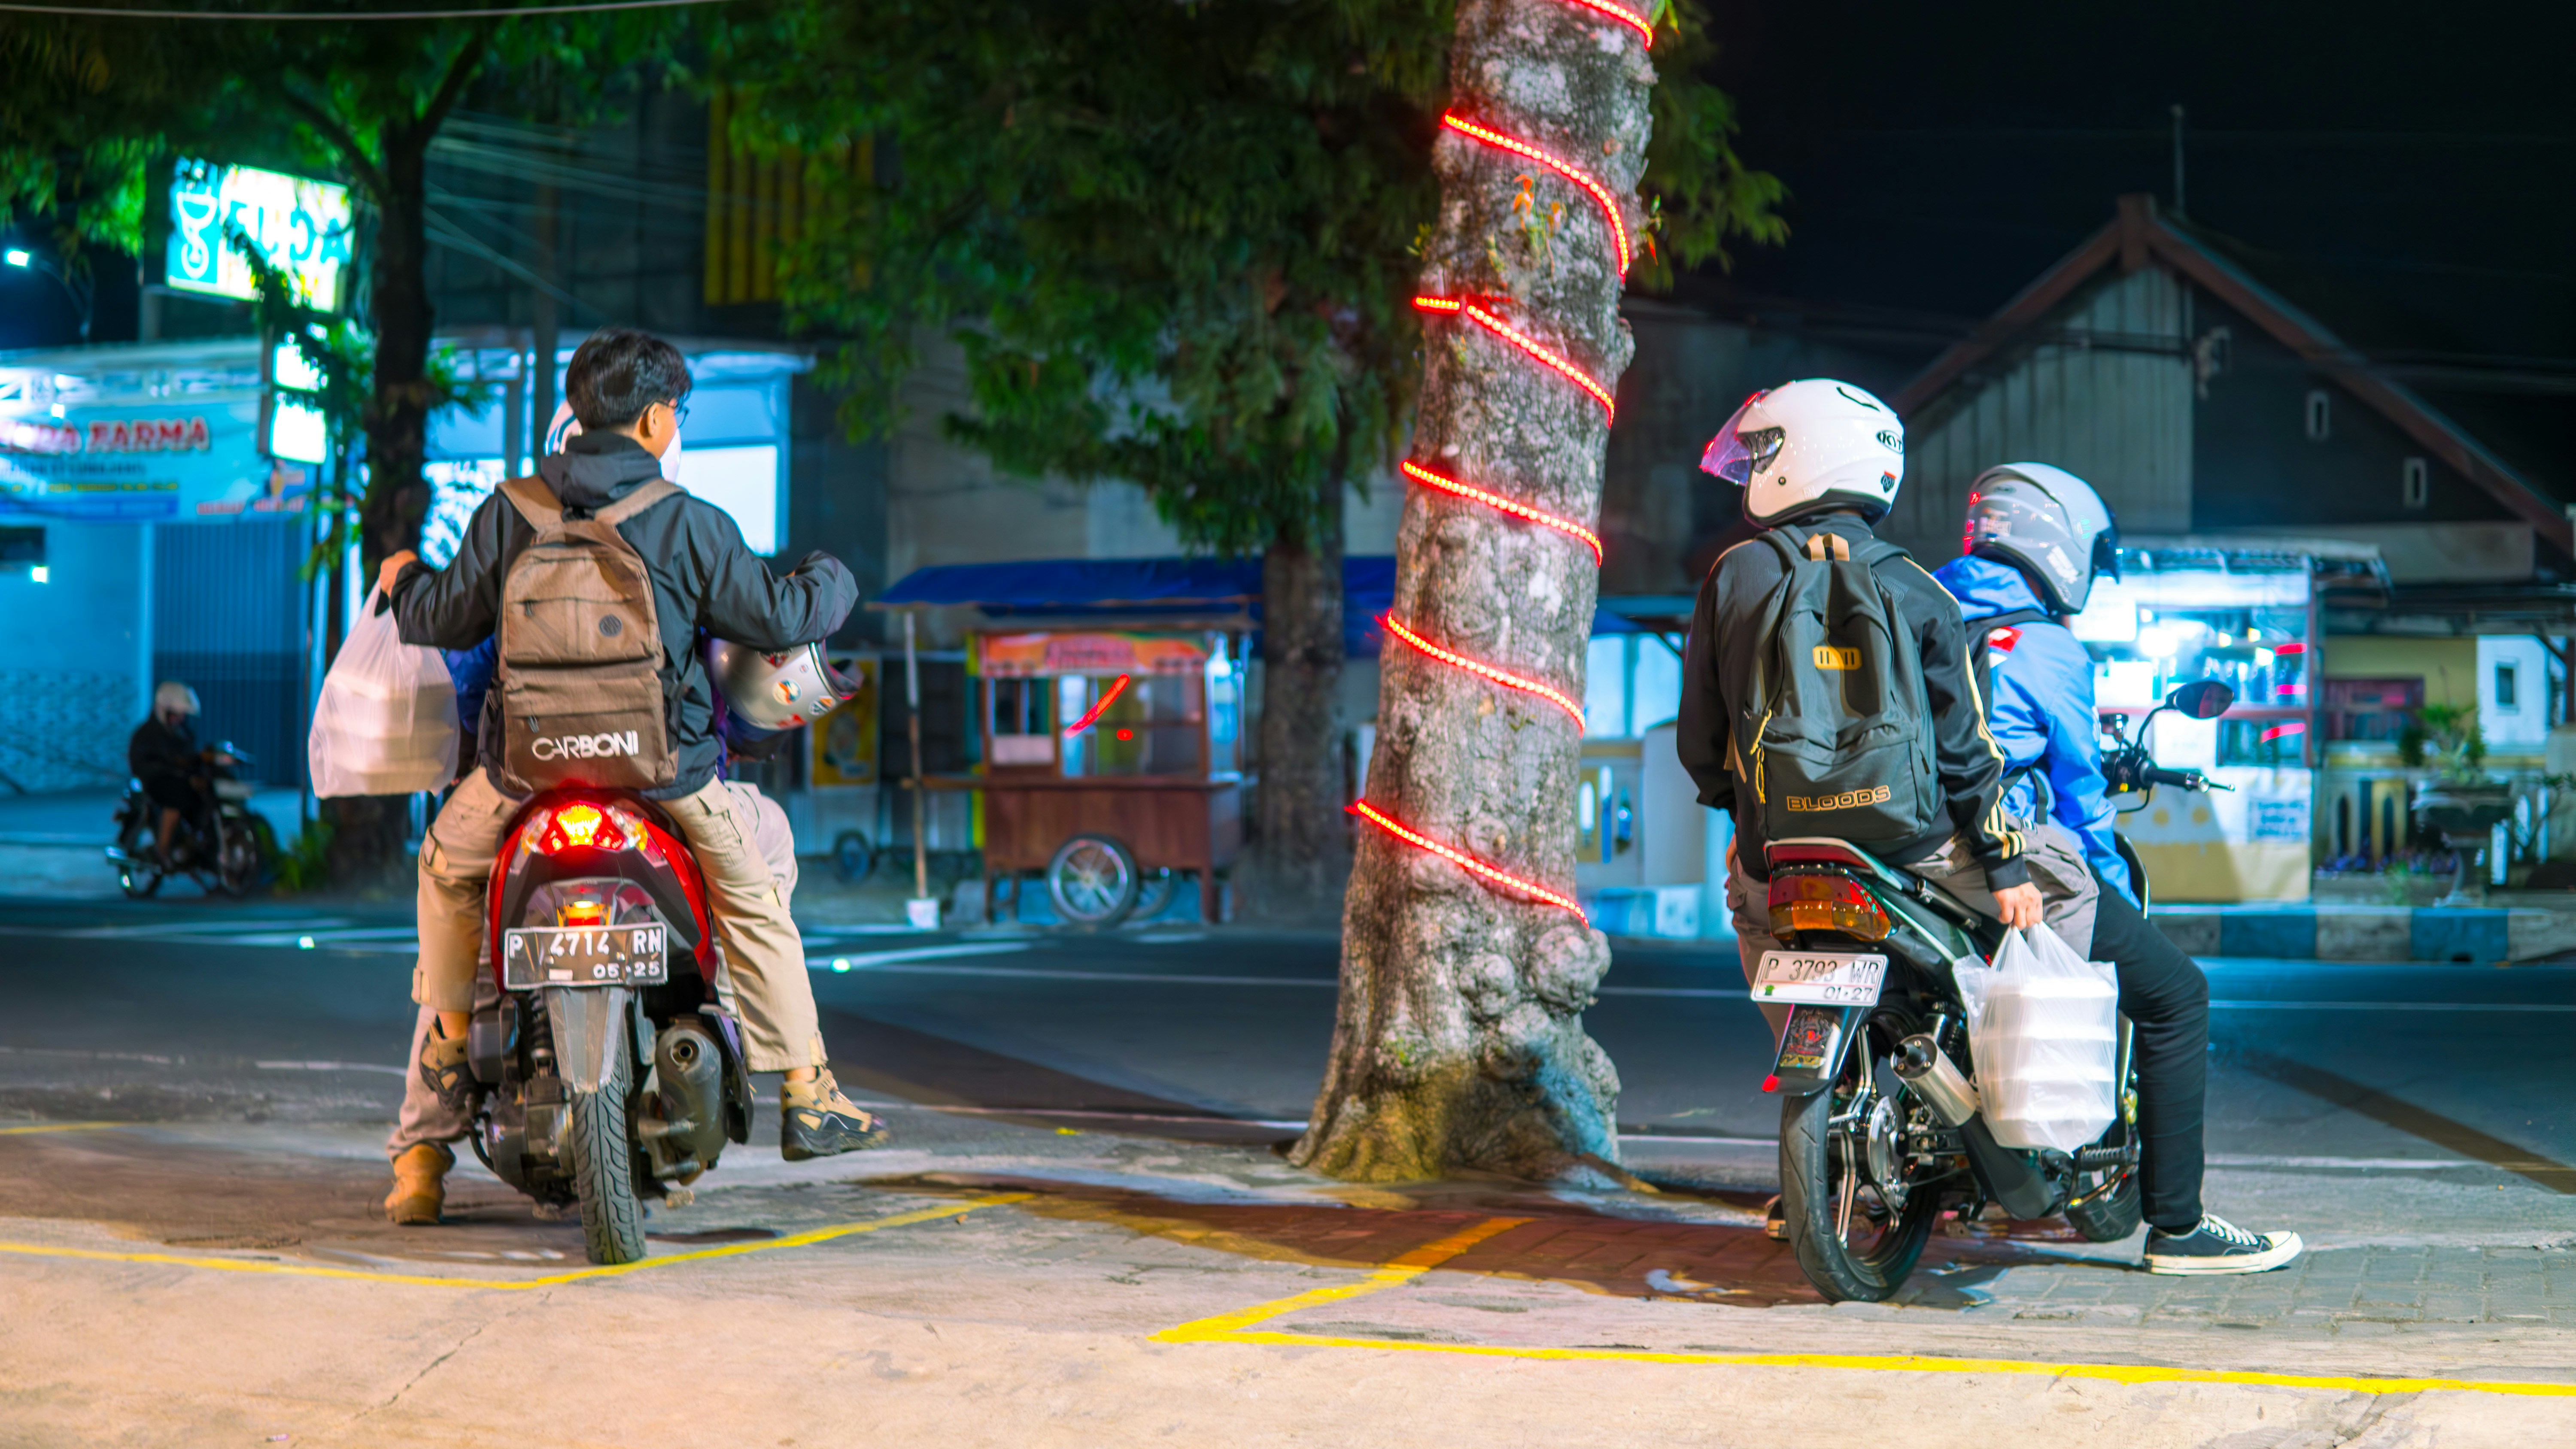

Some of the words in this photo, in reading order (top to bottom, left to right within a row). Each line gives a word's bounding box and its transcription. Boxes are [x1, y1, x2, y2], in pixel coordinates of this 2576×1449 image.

[532, 730, 639, 761] CARBONI
[1786, 785, 1891, 811] BLOODS
[509, 934, 523, 959] P
[550, 931, 609, 957] 4714
[633, 928, 662, 955] RN
[1765, 958, 1779, 979] P
[1789, 960, 1838, 982] 3793
[1849, 961, 1879, 984] WR
